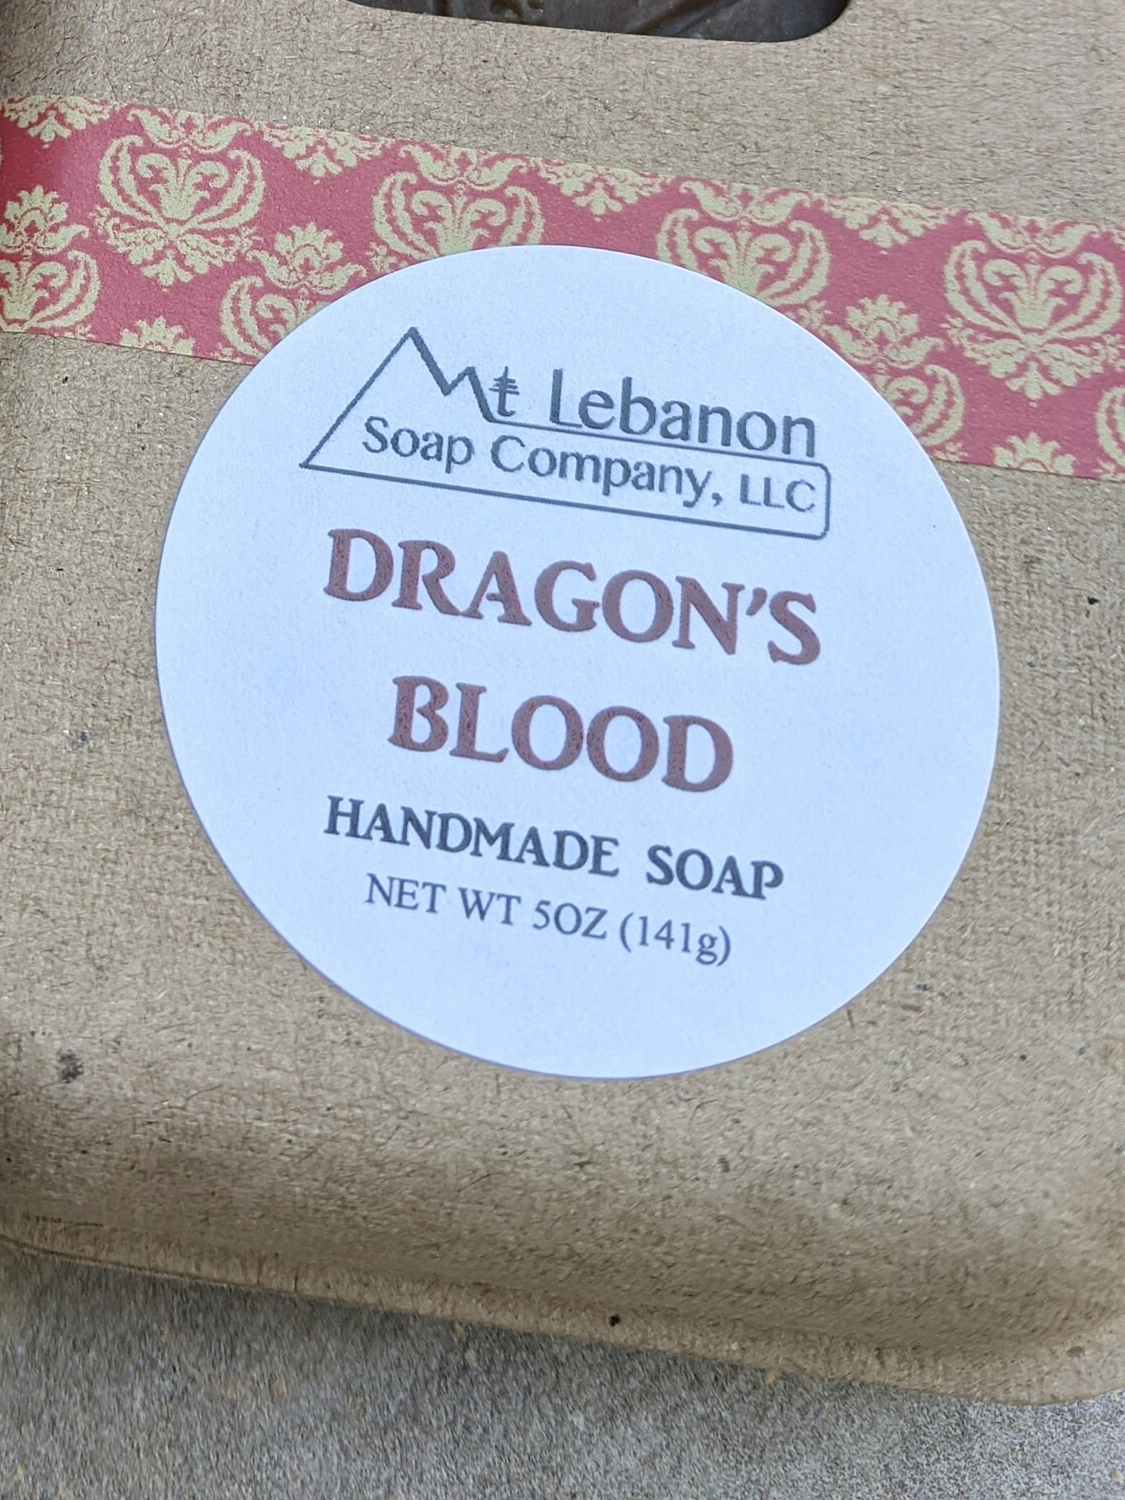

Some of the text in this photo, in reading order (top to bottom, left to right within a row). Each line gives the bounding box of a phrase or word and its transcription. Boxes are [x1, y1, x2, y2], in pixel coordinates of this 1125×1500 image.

[362, 415, 817, 513] Soap Company, LLC
[550, 368, 817, 458] Lebanon
[323, 528, 821, 666] DRAGON'S
[387, 674, 734, 793] BLOOD
[323, 795, 785, 901] HANDMADE SOAP
[365, 872, 733, 967] NET WT 5OZ (141g)
